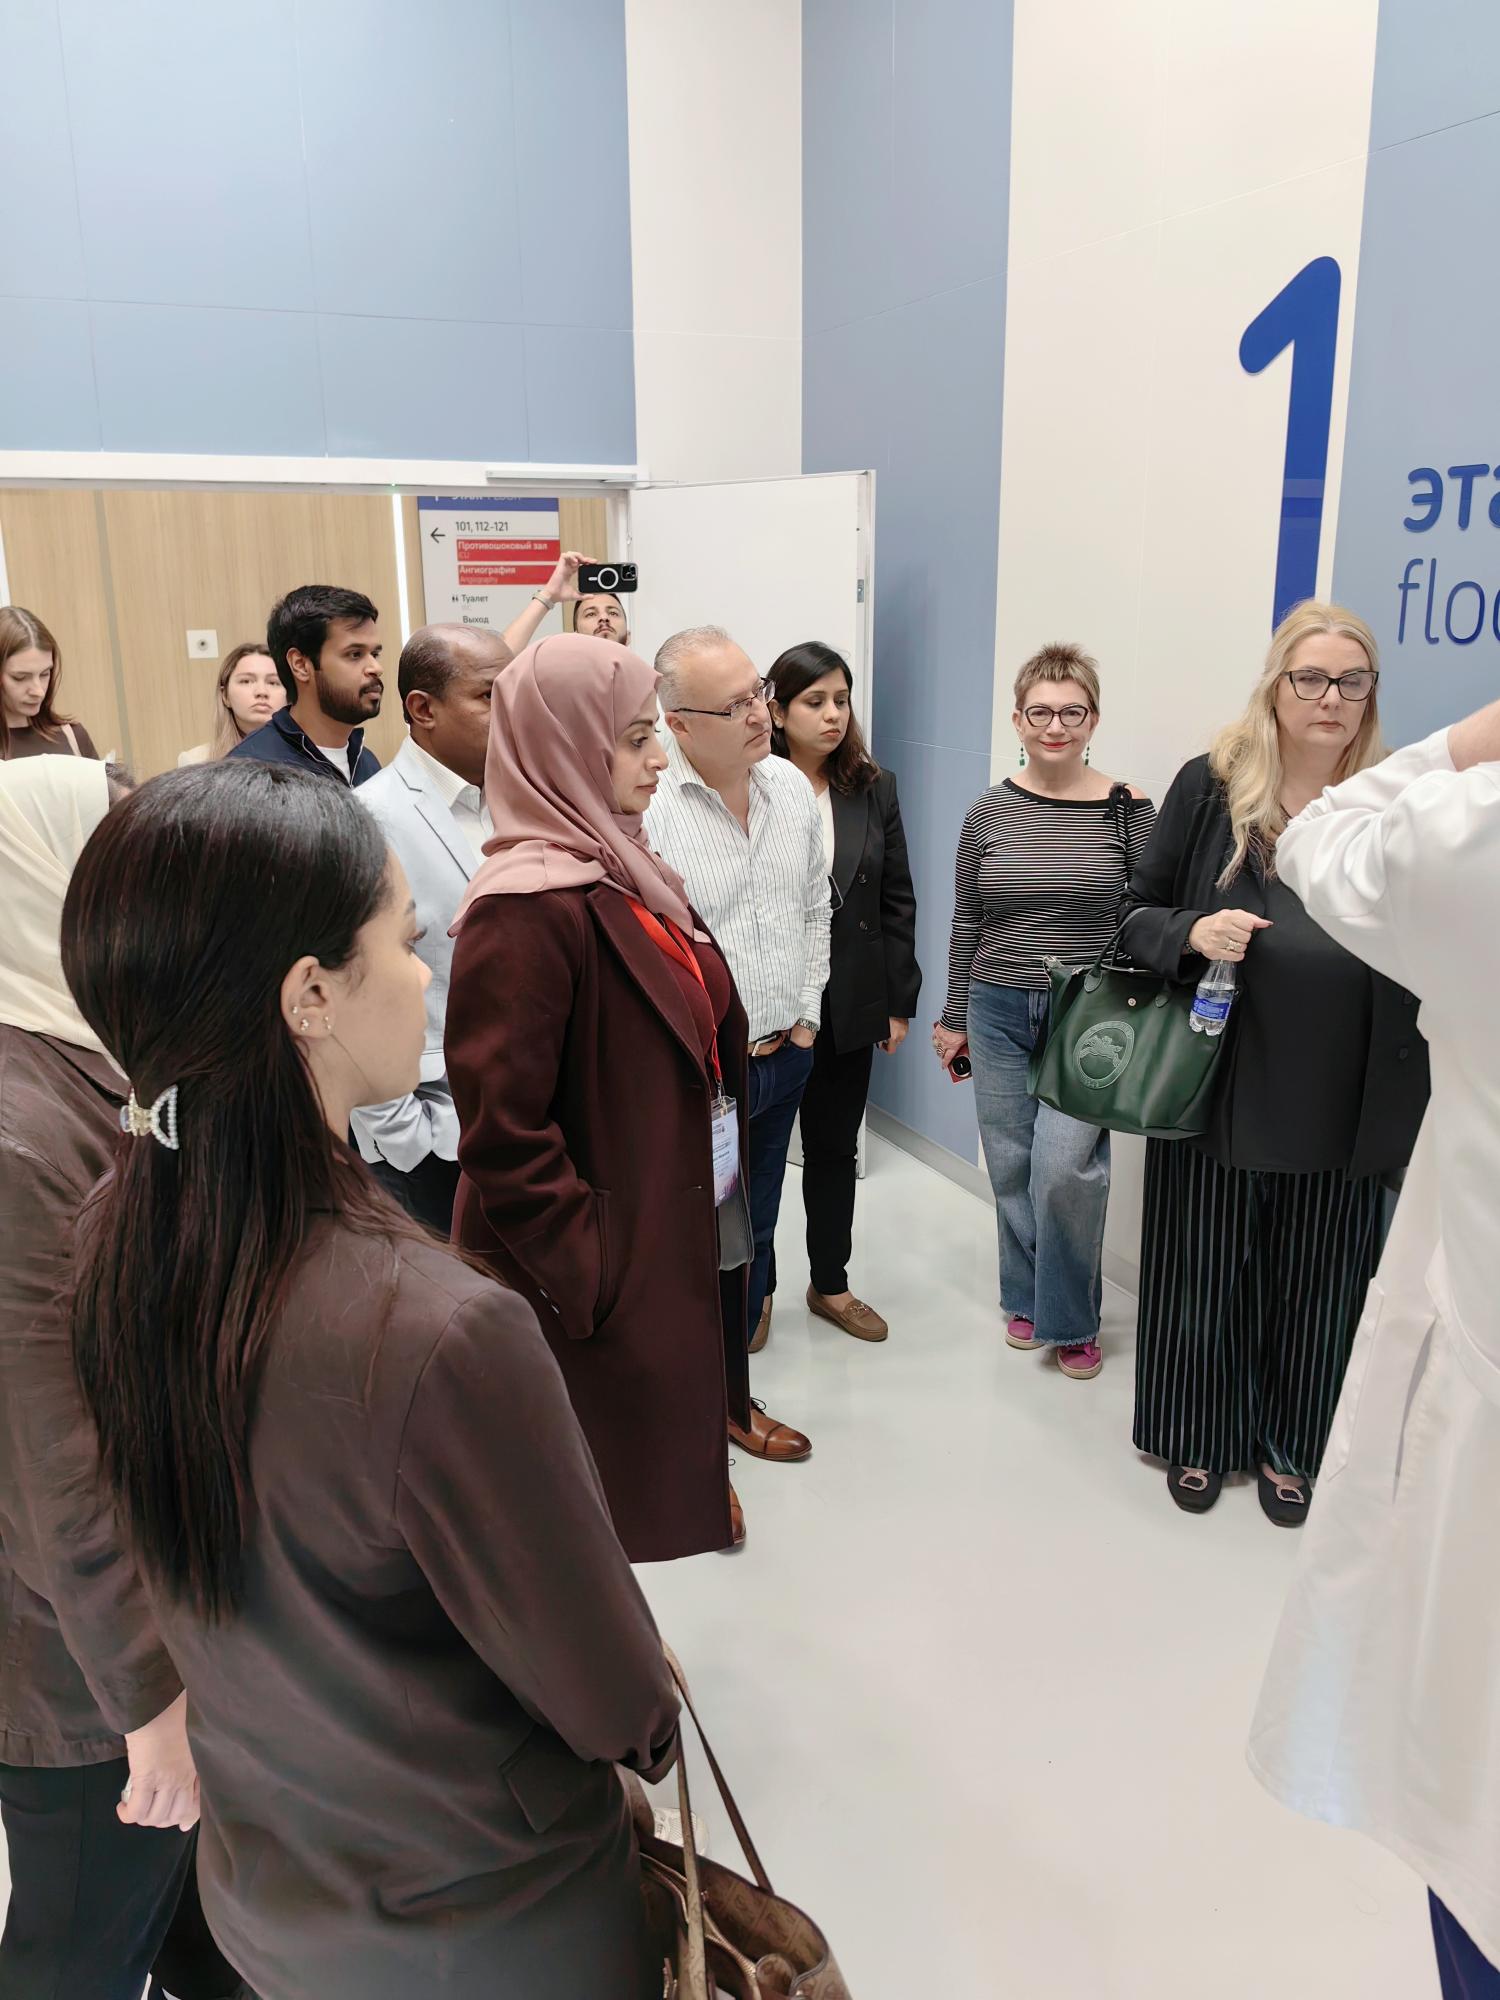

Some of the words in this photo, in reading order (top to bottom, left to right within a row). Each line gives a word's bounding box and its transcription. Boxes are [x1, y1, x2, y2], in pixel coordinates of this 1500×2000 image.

[1239, 256, 1341, 638] 1
[455, 521, 473, 533] 101,
[475, 521, 509, 532] 112-121
[458, 541, 531, 551] Противошоковый
[459, 566, 516, 576] Ангиография
[461, 594, 489, 604] Туалет
[463, 615, 489, 624] Выход
